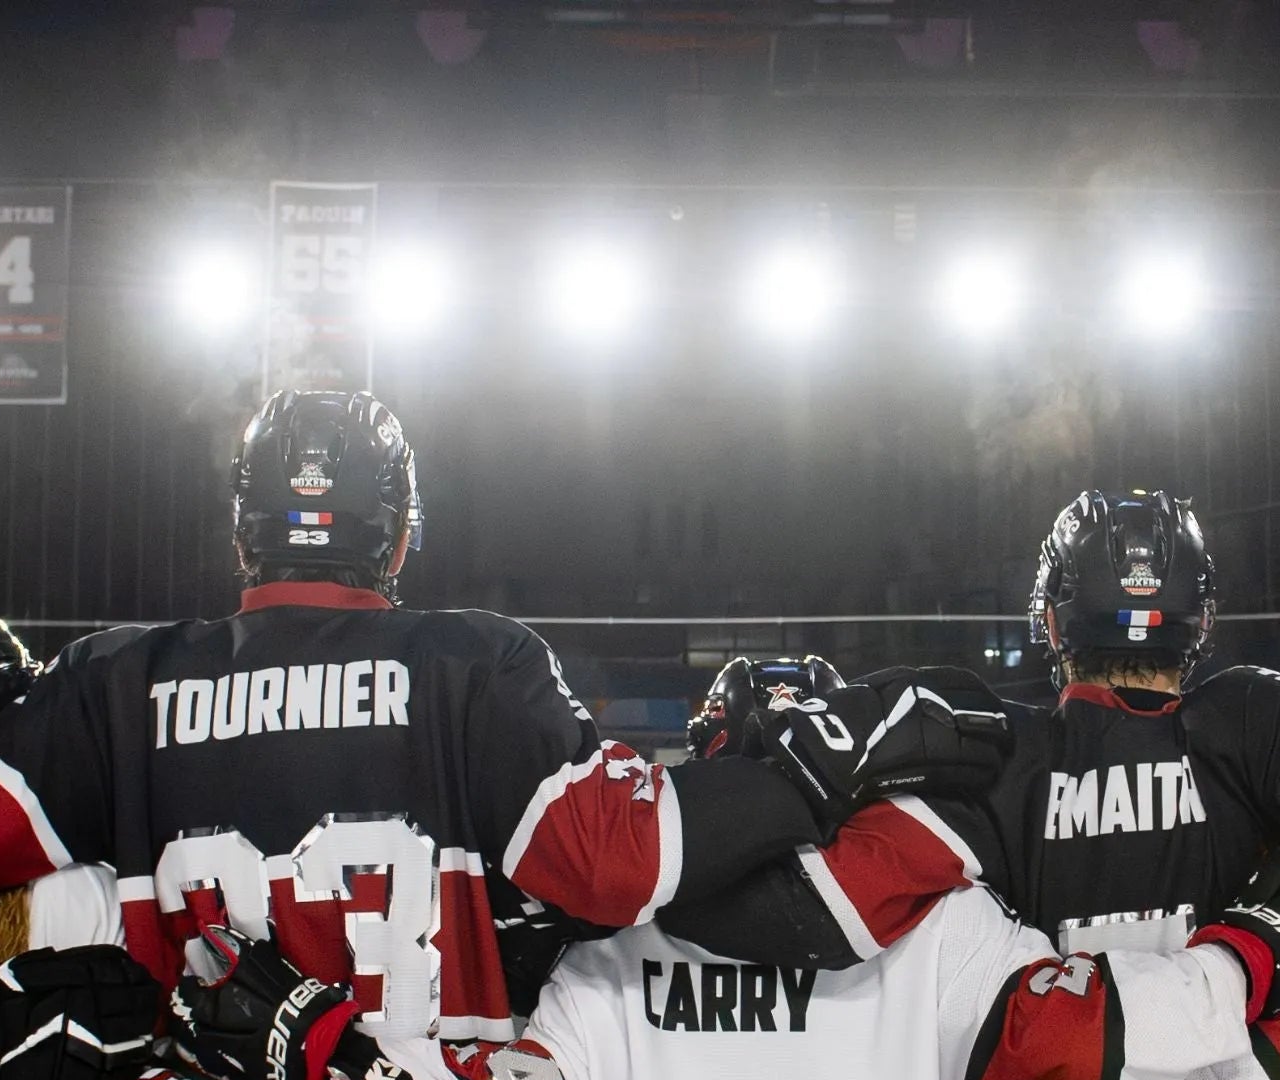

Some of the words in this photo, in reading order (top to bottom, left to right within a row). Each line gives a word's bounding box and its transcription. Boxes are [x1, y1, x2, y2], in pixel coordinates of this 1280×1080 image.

[288, 529, 330, 546] 23
[1127, 626, 1148, 641] 5
[149, 659, 411, 750] TOURNIER
[641, 956, 820, 1033] CARRY
